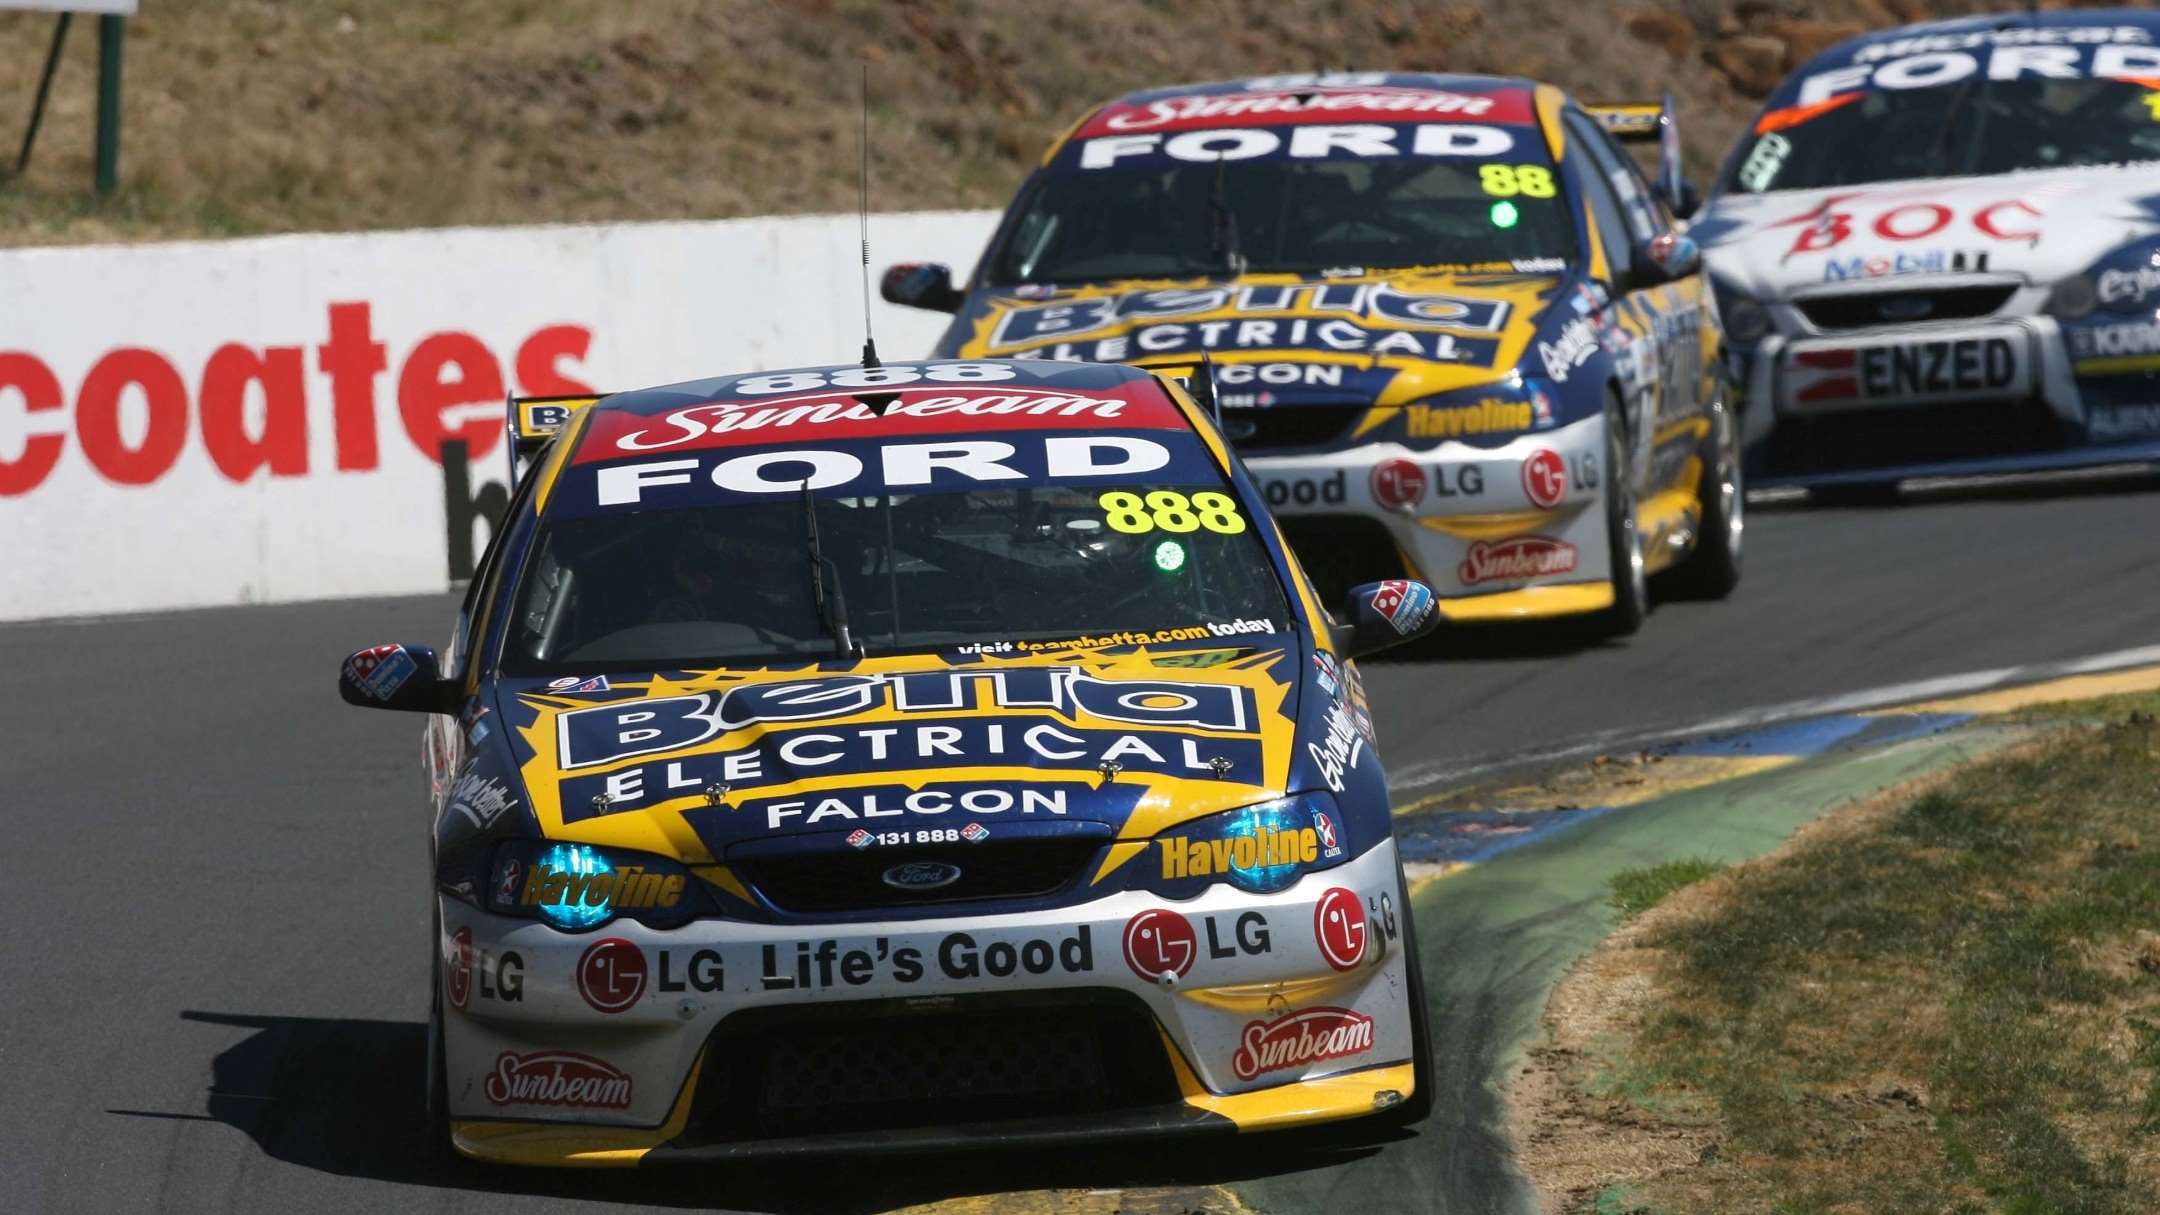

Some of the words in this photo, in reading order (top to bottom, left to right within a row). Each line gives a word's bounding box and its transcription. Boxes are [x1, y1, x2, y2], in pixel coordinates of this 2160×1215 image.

[1800, 45, 2160, 106] FORD
[1080, 124, 1515, 169] FORD
[1479, 164, 1557, 198] 88
[735, 365, 1017, 394] 888
[1218, 364, 1343, 386] CON
[1862, 339, 2016, 397] ENZED
[597, 436, 1171, 506] FORD
[1254, 469, 1346, 503] ood
[1436, 463, 1484, 496] LG
[1099, 491, 1246, 534] 888
[1206, 617, 1275, 636] today
[607, 724, 1213, 802] ELECTRICAL
[767, 789, 1067, 829] FALCON
[876, 832, 911, 846] 131
[916, 829, 960, 843] 888
[1157, 825, 1319, 879] Havoline
[522, 864, 687, 908] Havoline
[658, 949, 724, 993] LG
[760, 937, 925, 990] Life's
[937, 925, 1094, 980] Good
[1204, 911, 1272, 960] LG
[1234, 1010, 1373, 1077] Sunbeam
[487, 1055, 631, 1105] Sunbeam
